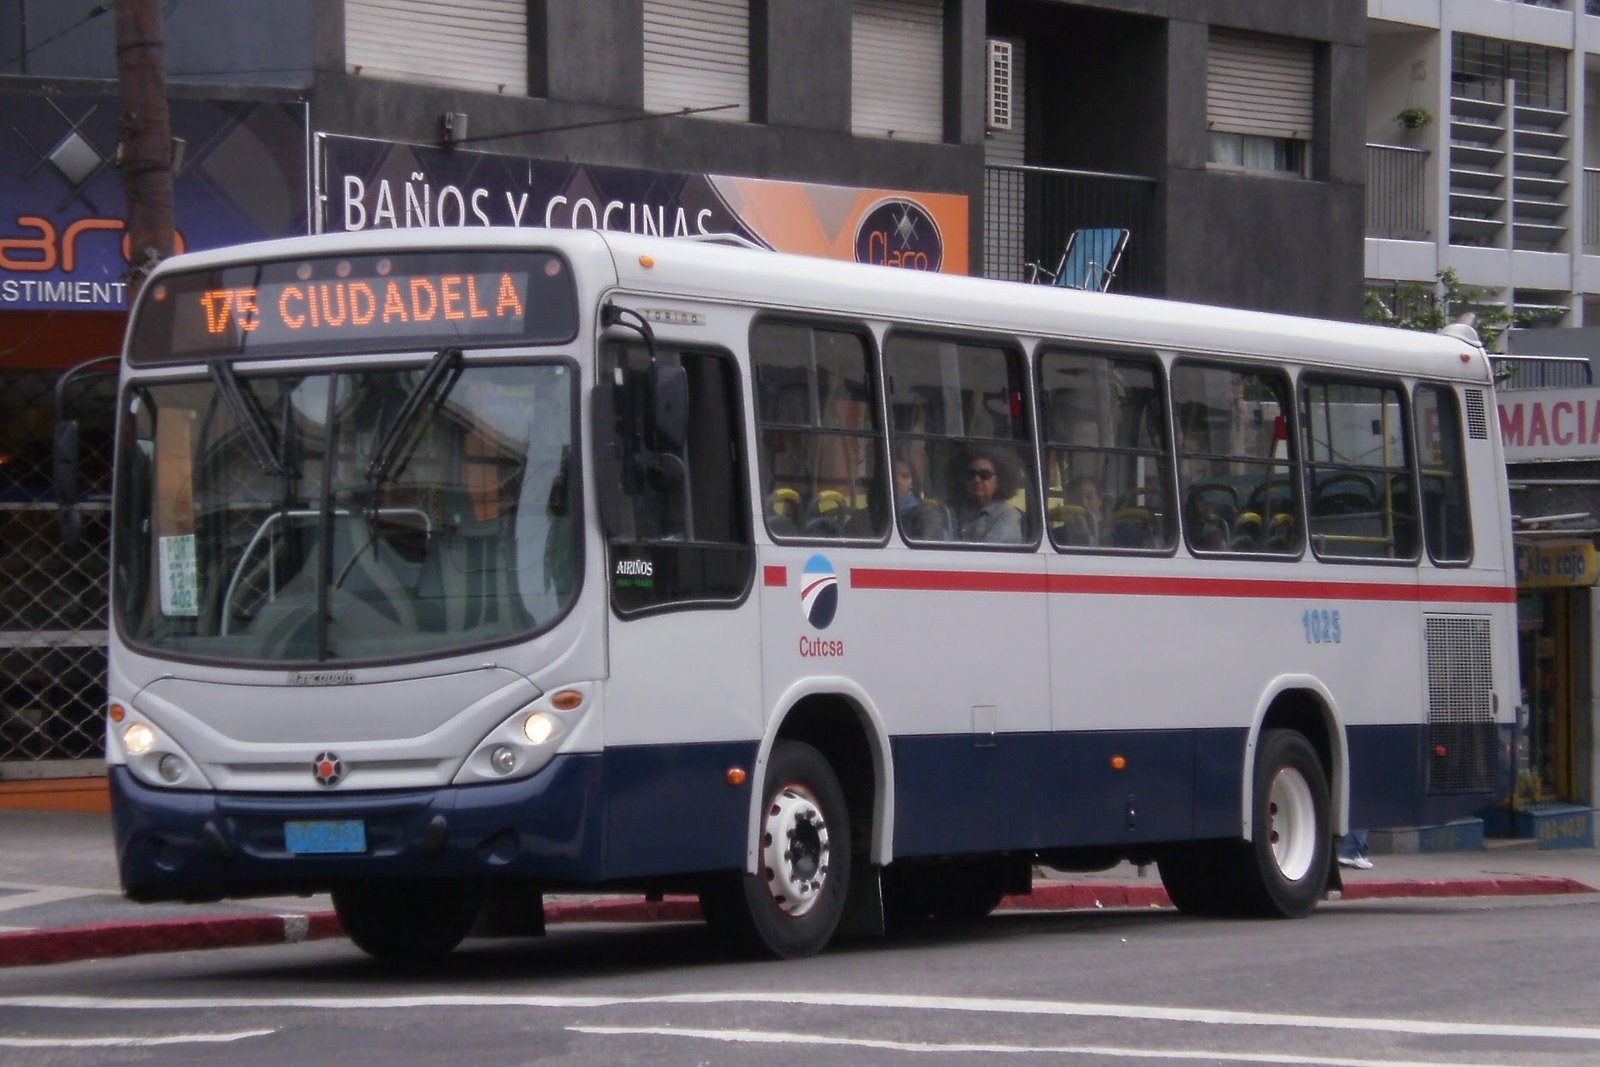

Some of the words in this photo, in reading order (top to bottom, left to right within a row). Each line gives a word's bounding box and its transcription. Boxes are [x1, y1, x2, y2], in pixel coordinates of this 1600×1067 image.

[344, 171, 491, 231] BAÑOS
[506, 191, 528, 227] Y
[545, 195, 712, 237] COCINAS
[869, 230, 928, 271] Claro
[200, 288, 260, 333] 175
[616, 559, 653, 576] AIRIÑOS
[1302, 609, 1342, 644] 1025
[799, 635, 844, 657] Cutcsa
